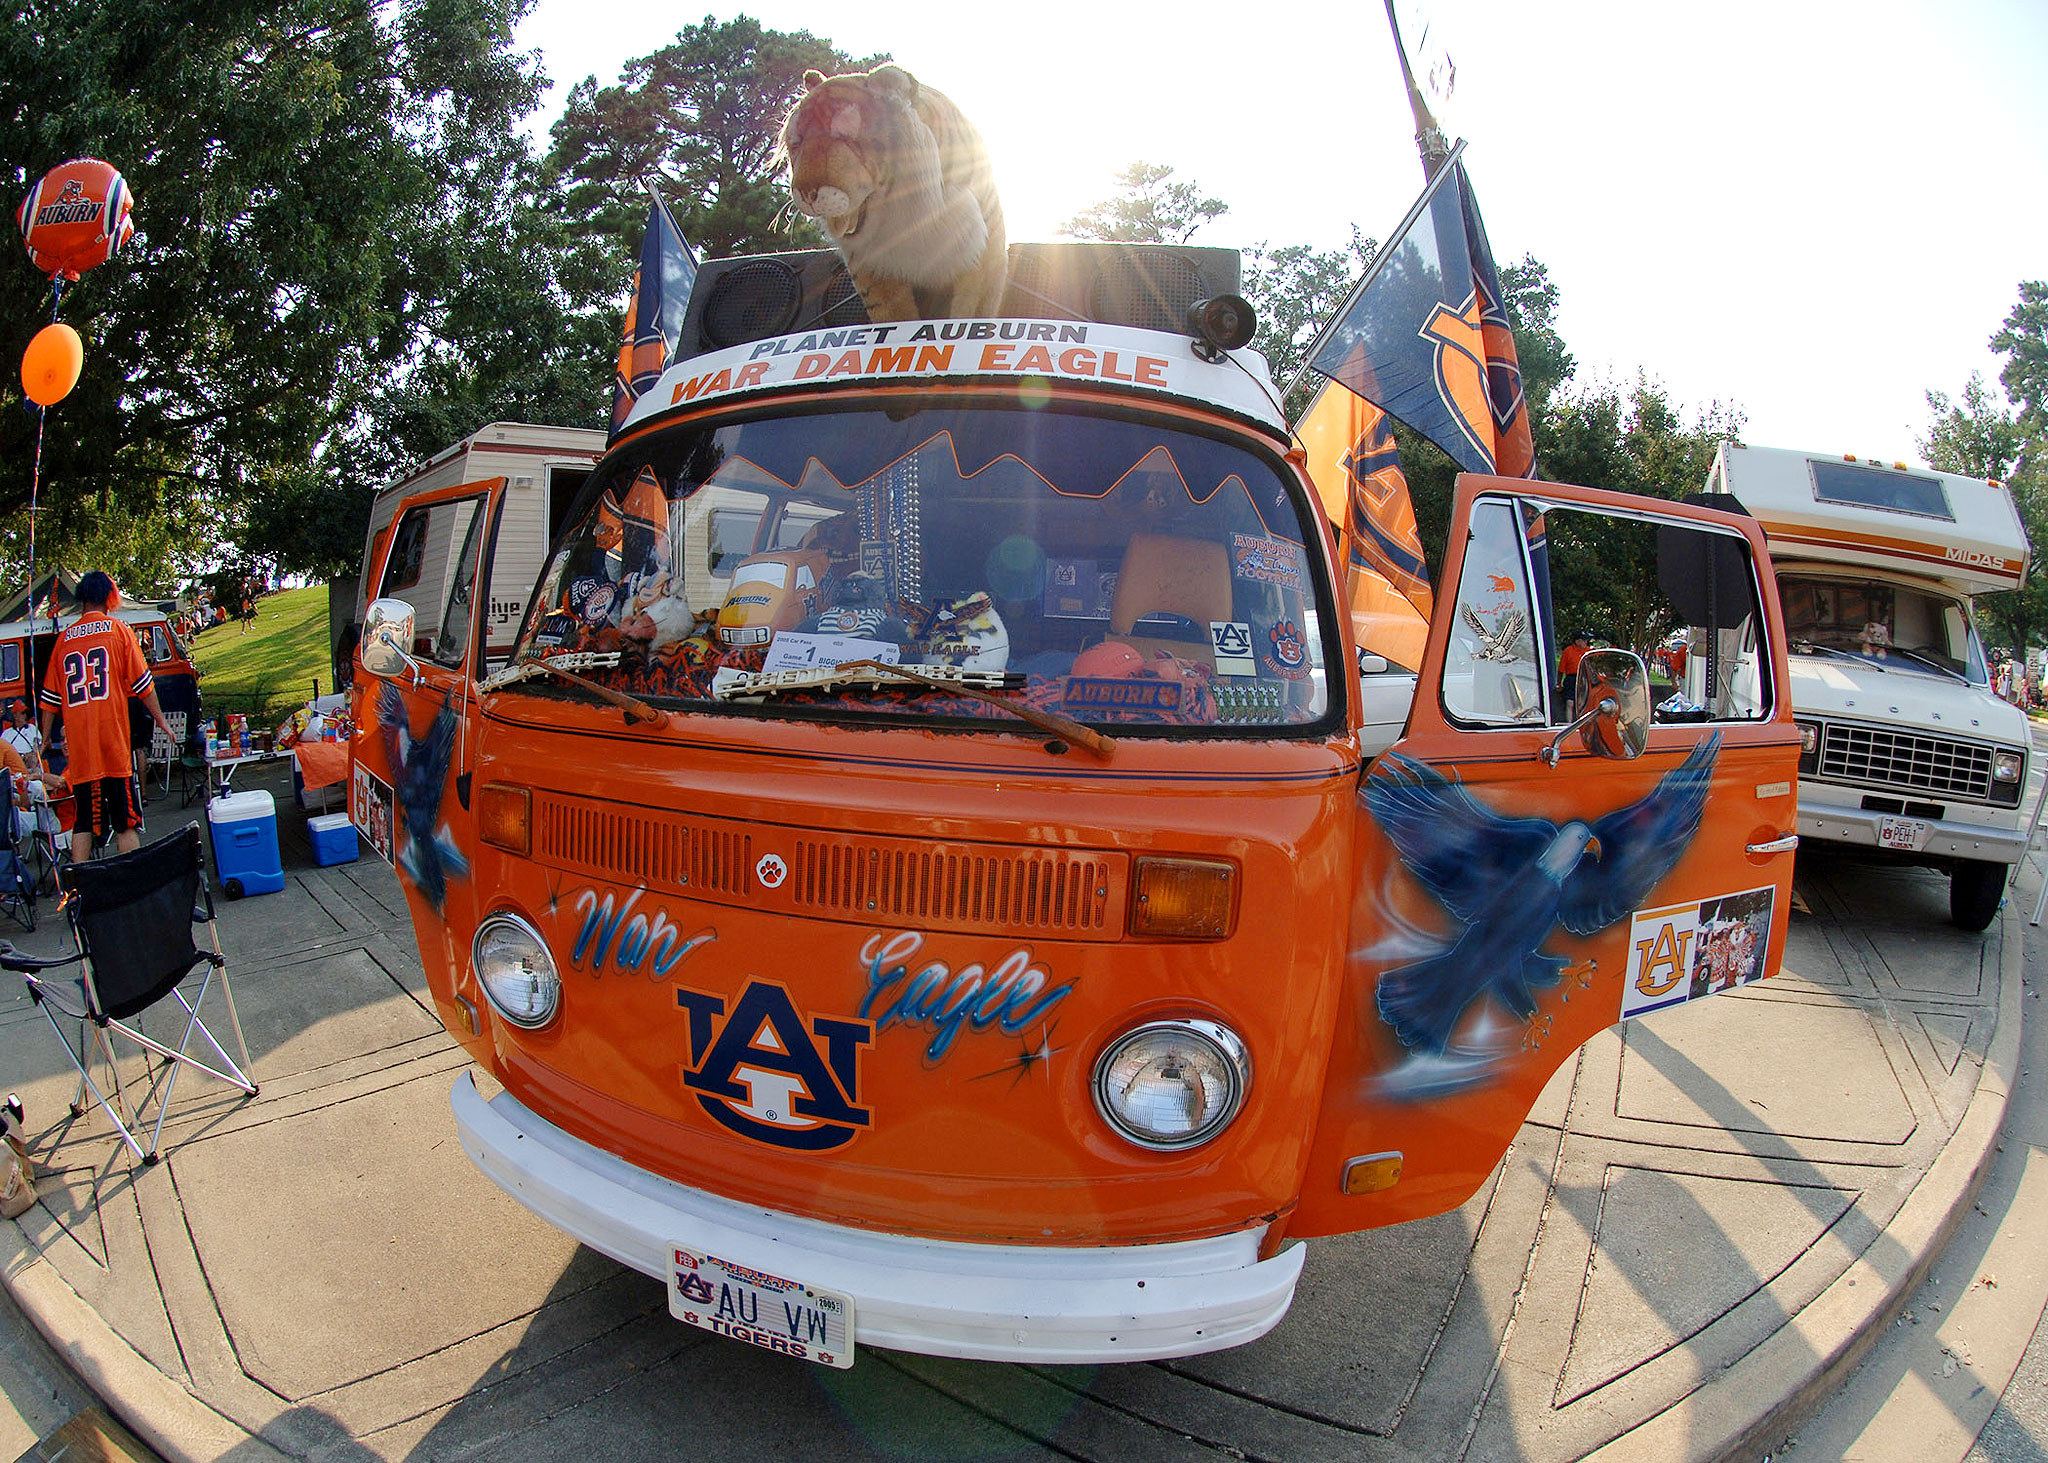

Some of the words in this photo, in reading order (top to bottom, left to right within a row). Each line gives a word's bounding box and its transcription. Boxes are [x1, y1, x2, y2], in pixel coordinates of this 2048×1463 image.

[34, 203, 103, 226] AUBURN
[750, 326, 898, 361] PLANET
[909, 322, 1088, 345] AUBURN
[670, 361, 774, 406] WAR
[795, 345, 953, 383] DAMN
[978, 344, 1170, 388] EAGLE
[1234, 535, 1297, 559] AUBURN
[1946, 547, 2005, 569] MIDAS
[64, 620, 113, 641] AUBURN
[783, 653, 802, 661] Game
[806, 646, 817, 662] 1
[900, 643, 930, 655] WAR
[932, 644, 981, 656] EAGLE
[63, 646, 110, 707] 23
[1068, 682, 1157, 705] AUBURN
[572, 884, 718, 978] War
[859, 930, 1077, 1066] Eagle
[679, 1253, 693, 1267] FEB
[720, 1282, 758, 1323] AU
[784, 1301, 827, 1345] VW
[707, 1316, 807, 1358] TIGERS
